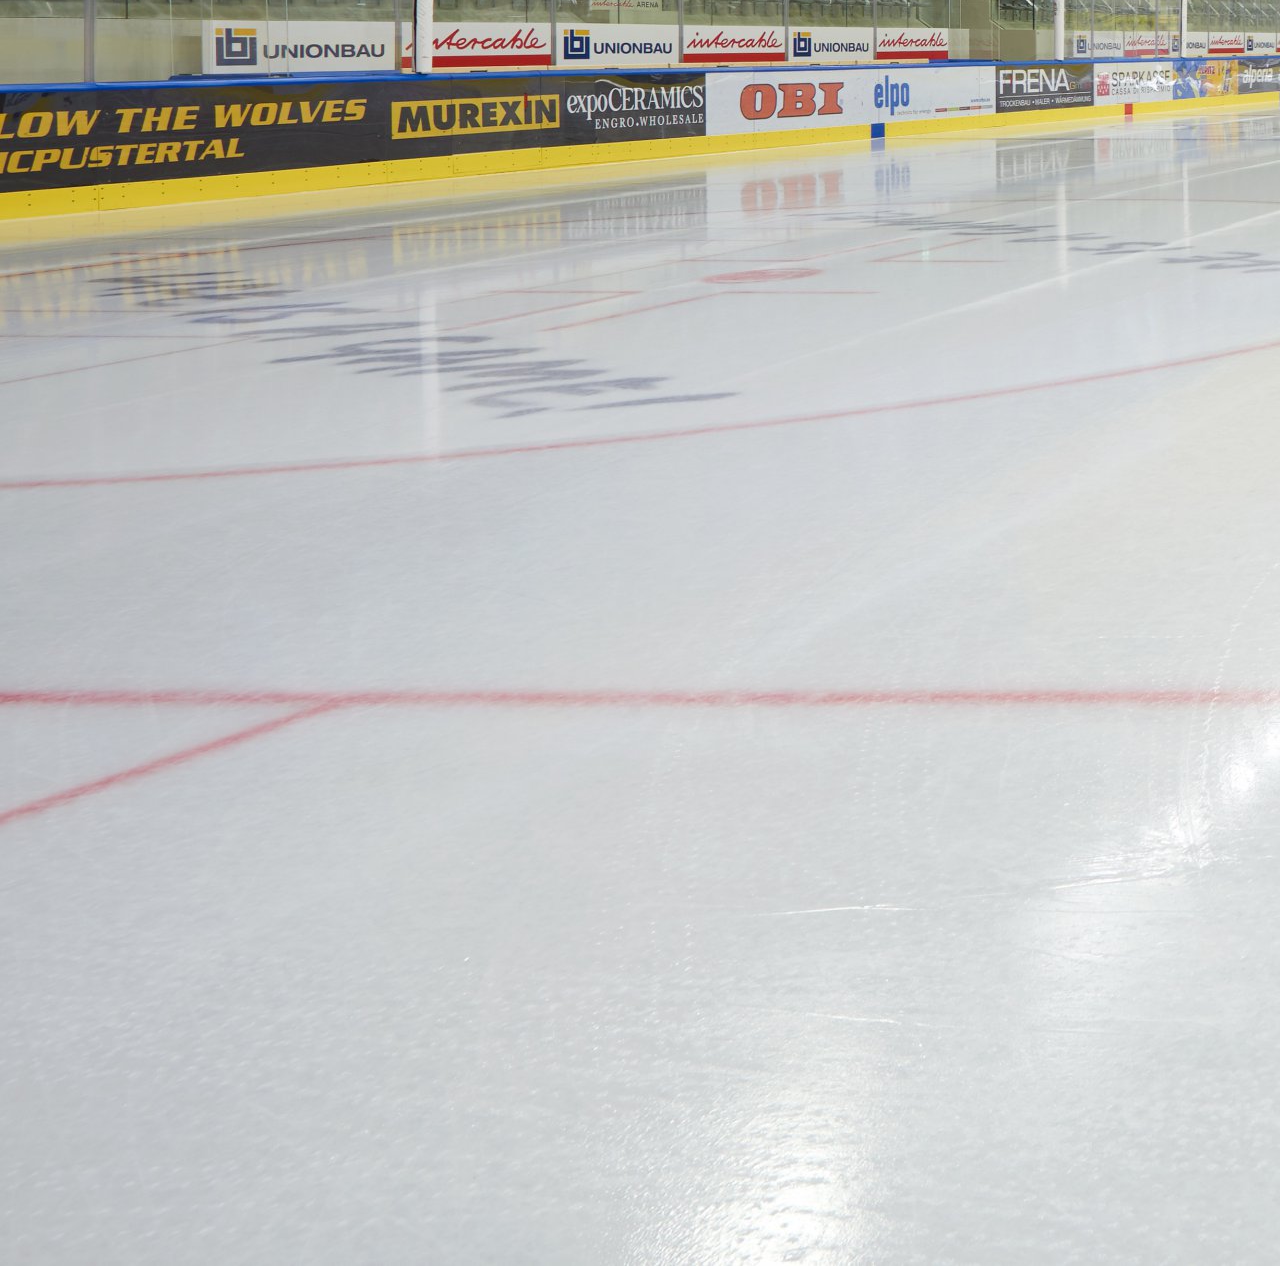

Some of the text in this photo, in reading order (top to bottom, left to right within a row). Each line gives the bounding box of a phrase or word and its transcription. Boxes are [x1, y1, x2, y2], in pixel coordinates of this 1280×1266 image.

[636, 1, 659, 9] ARENA
[594, 42, 672, 55] UNIONBAU
[687, 31, 783, 50] intercable
[814, 42, 869, 53] UNIONBAU
[879, 32, 948, 48] intercable
[1088, 42, 1121, 51] UNIONBAU
[263, 43, 385, 59] UNIONBAU
[1000, 68, 1071, 94] FRENA
[1112, 70, 1170, 86] SPARKASSE
[1243, 65, 1273, 88] alperia
[874, 75, 910, 116] elpo
[1112, 88, 1131, 96] CASSA
[566, 86, 704, 121] expoCERAMICS
[740, 82, 844, 121] OBI
[116, 105, 200, 133] THE
[214, 99, 368, 128] WOLVES
[397, 93, 557, 133] MUREXIN
